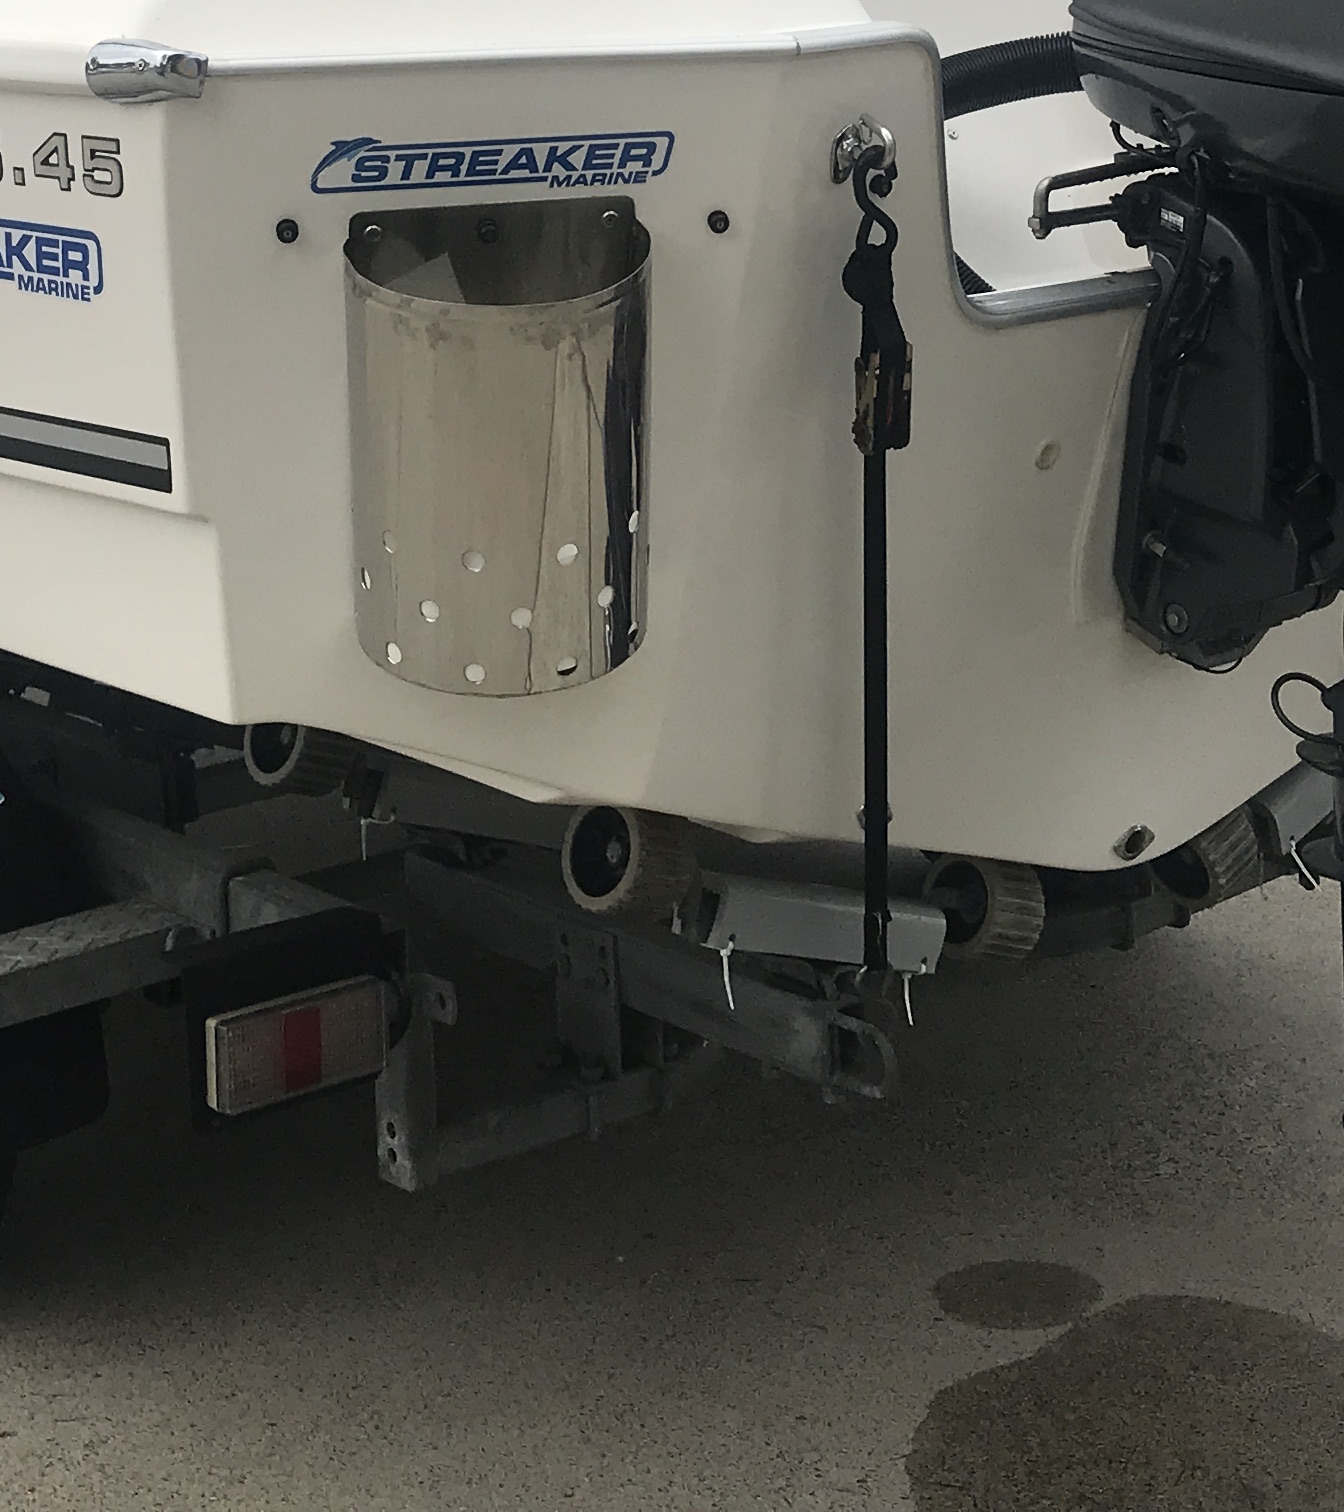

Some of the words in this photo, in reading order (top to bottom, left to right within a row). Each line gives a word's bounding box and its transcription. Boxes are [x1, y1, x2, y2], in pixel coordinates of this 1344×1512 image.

[350, 140, 657, 184] STREAKER
[548, 170, 649, 189] MARINE
[17, 274, 91, 302] MARINE
